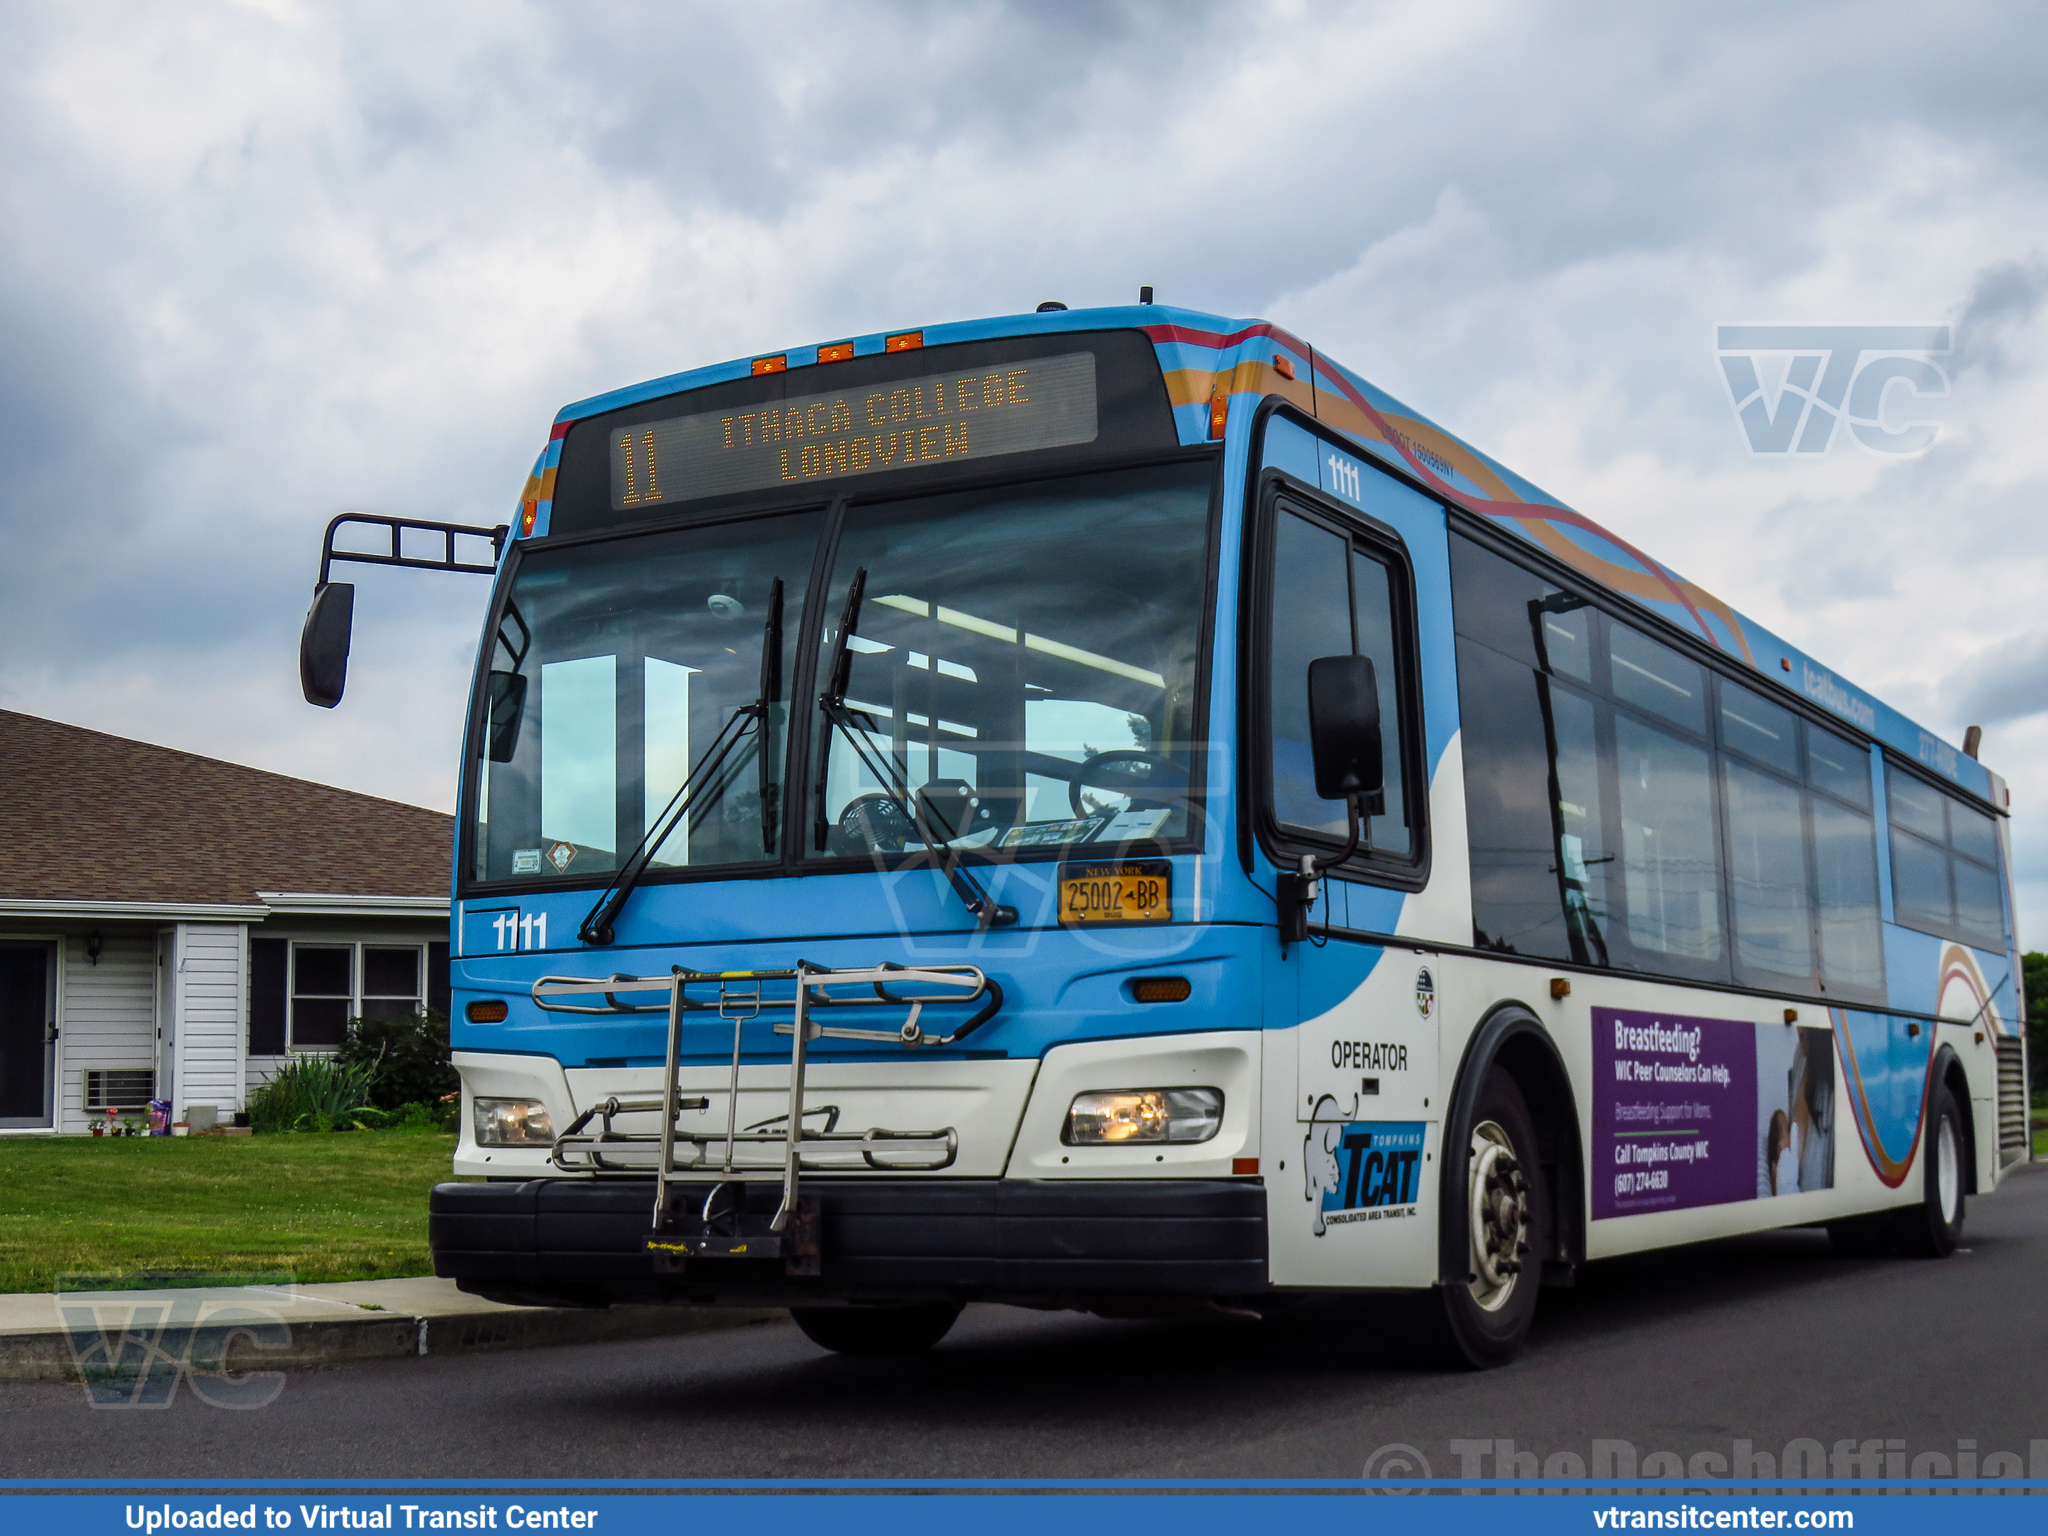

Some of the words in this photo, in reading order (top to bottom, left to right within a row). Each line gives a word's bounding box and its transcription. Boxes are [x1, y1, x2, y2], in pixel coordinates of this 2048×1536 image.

[720, 399, 851, 448] ITHACA
[866, 369, 1030, 427] COLLEGE
[620, 429, 662, 505] 11
[779, 421, 969, 481] LONGVIEW
[1328, 454, 1360, 502] 1111
[1086, 868, 1112, 878] NEW
[1114, 866, 1142, 876] YORK
[1068, 881, 1123, 911] 25002
[1137, 880, 1159, 909] BB
[493, 912, 547, 950] 1111
[1332, 1040, 1408, 1071] OPERATOR
[1615, 1020, 1701, 1062] Breastfeeding?
[1615, 1060, 1632, 1082] WIC
[1634, 1061, 1653, 1082] Peer
[1654, 1062, 1696, 1083] Counselors
[1697, 1063, 1711, 1083] Can
[1712, 1064, 1731, 1088] Help.
[1373, 1134, 1420, 1146] TOMPKINS
[1615, 1144, 1631, 1164] Call
[1631, 1142, 1669, 1168] Tompkins
[1669, 1142, 1694, 1165] County
[1695, 1141, 1709, 1158] WIC
[1344, 1133, 1418, 1209] TCAT
[1326, 1212, 1367, 1225] CONSOLIDATED
[1368, 1211, 1382, 1221] AREA
